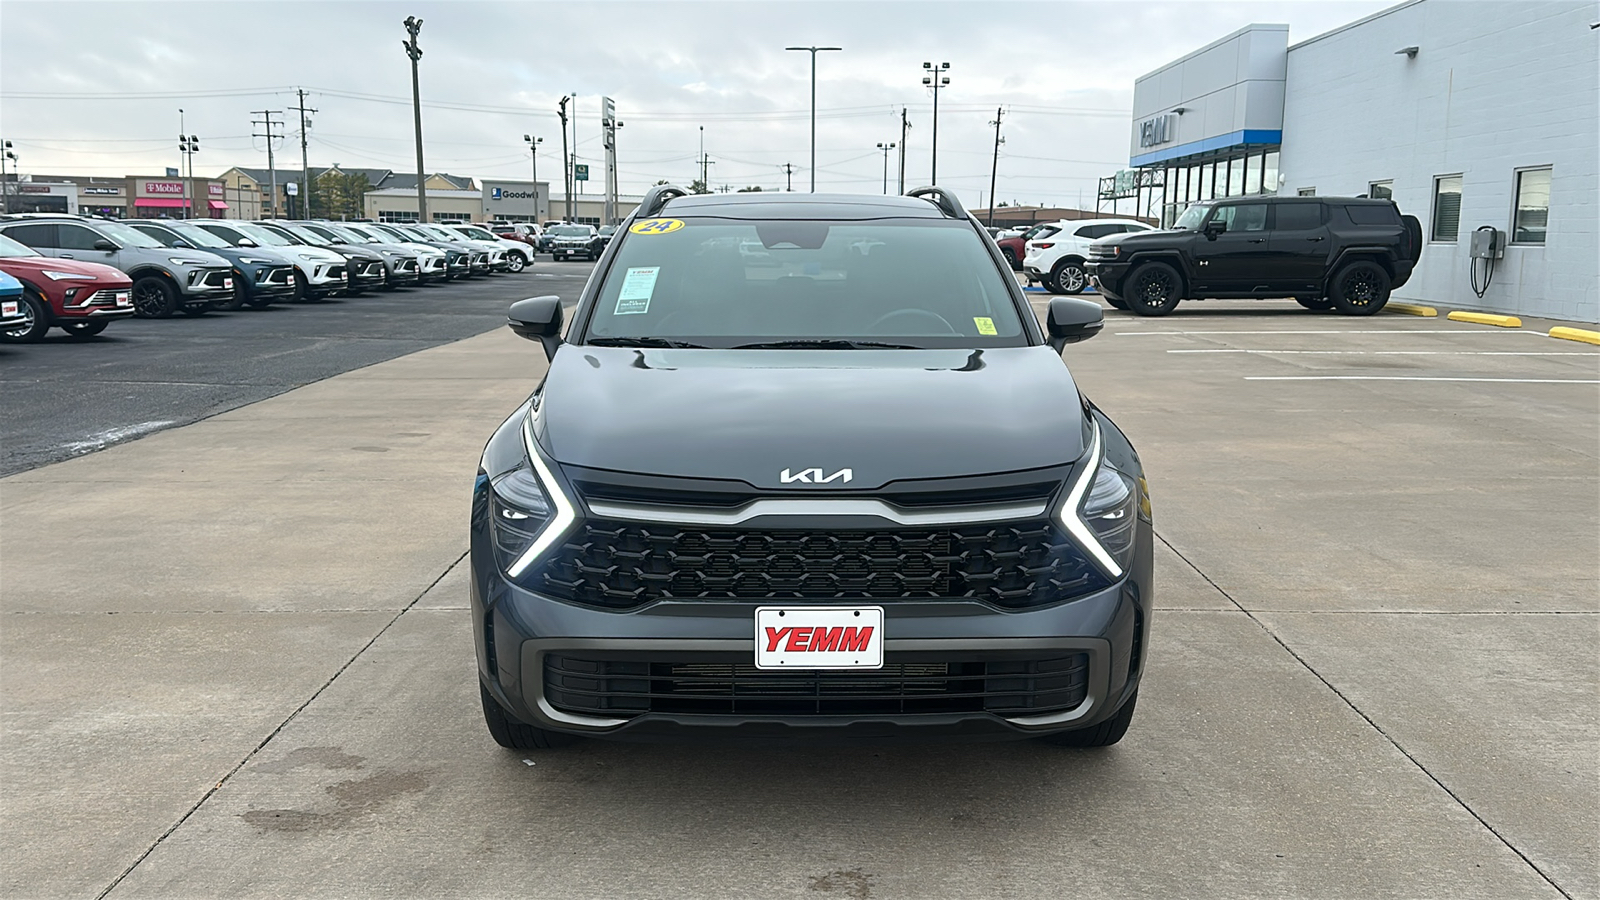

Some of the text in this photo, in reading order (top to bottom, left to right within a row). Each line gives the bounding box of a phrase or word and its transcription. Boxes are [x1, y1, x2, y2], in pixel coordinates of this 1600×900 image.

[155, 184, 181, 193] Mobile
[502, 190, 539, 199] Goodwil
[638, 221, 674, 232] 24
[780, 468, 853, 484] KIA
[764, 626, 875, 653] YEMM
